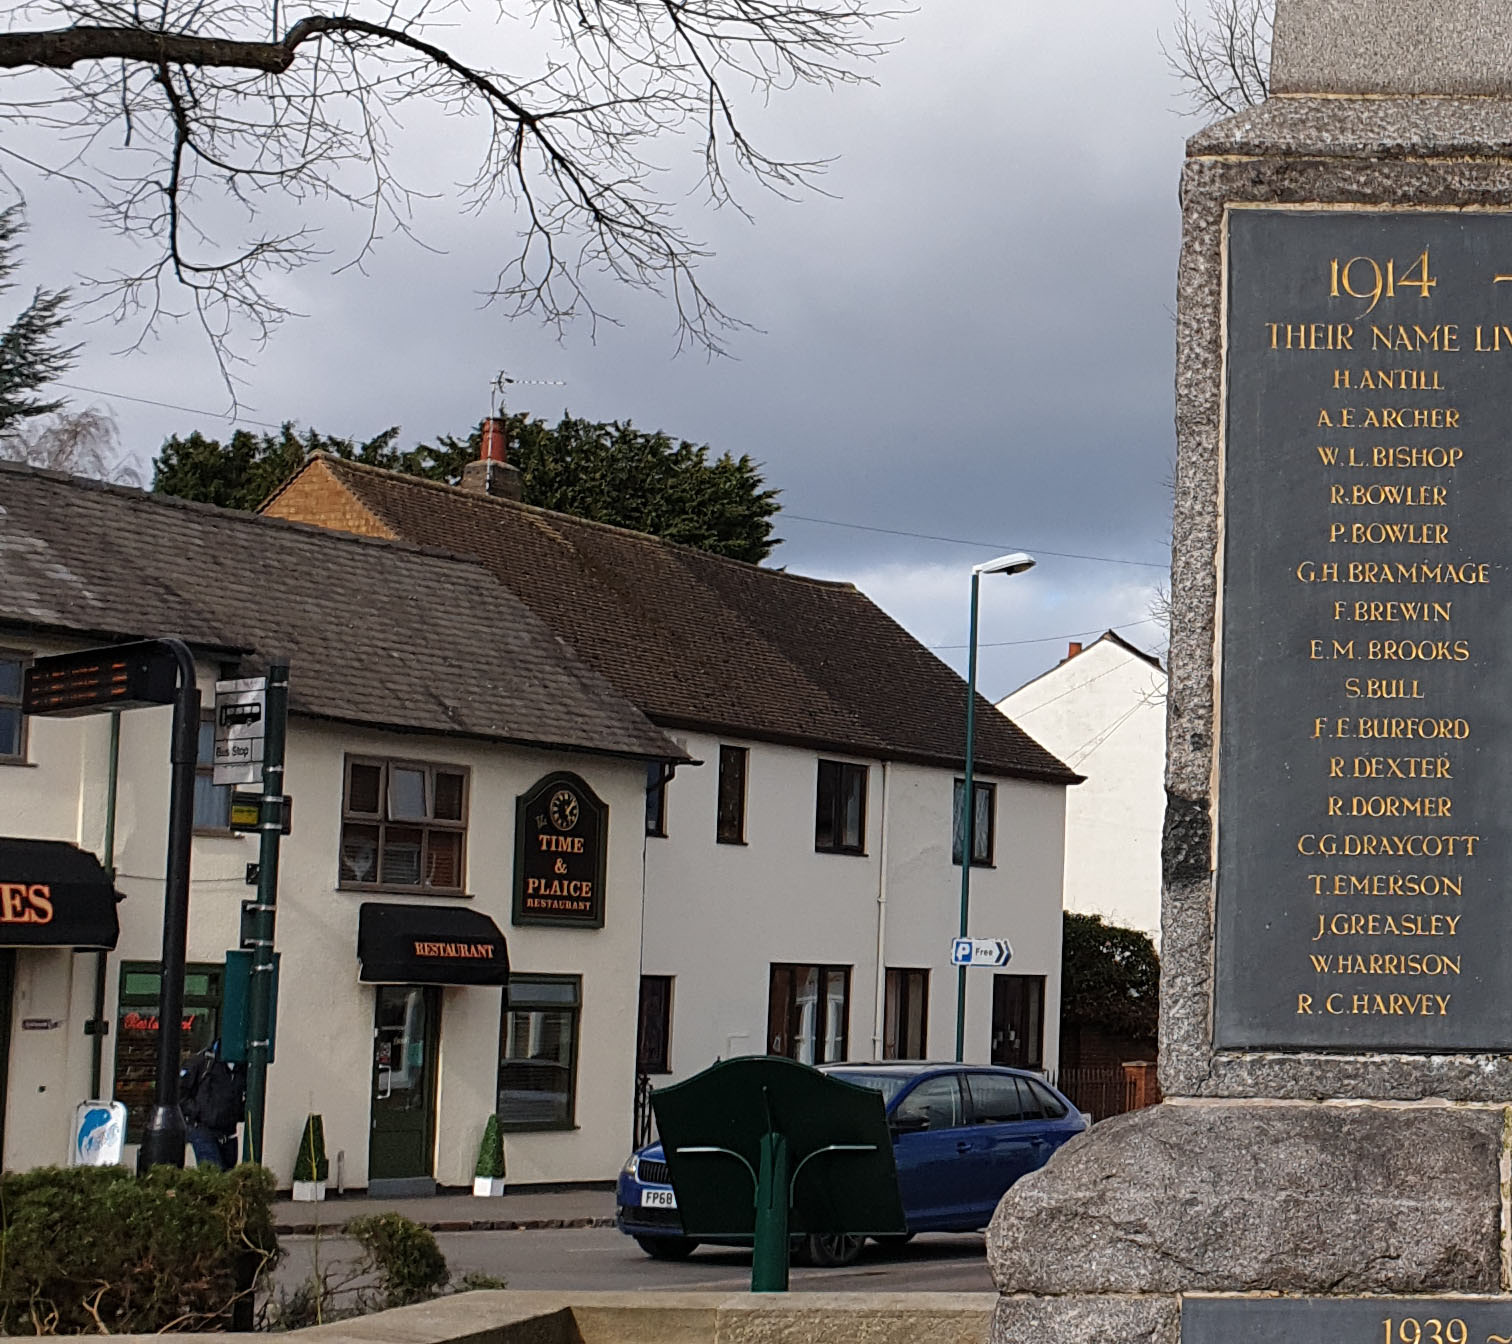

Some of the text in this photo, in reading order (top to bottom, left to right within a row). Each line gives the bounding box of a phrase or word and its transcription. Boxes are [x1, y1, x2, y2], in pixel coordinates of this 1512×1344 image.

[1330, 250, 1438, 320] 1914
[1266, 323, 1354, 352] THEIR
[1371, 324, 1460, 352] NAME
[1334, 368, 1444, 389] H.ANTILL
[232, 745, 249, 758] Stop
[539, 835, 584, 853] TIME
[555, 858, 567, 874] &
[527, 878, 592, 897] PLAICE
[526, 899, 592, 911] RESTAURANT
[414, 942, 495, 959] RESTAURANT
[975, 947, 994, 957] Free
